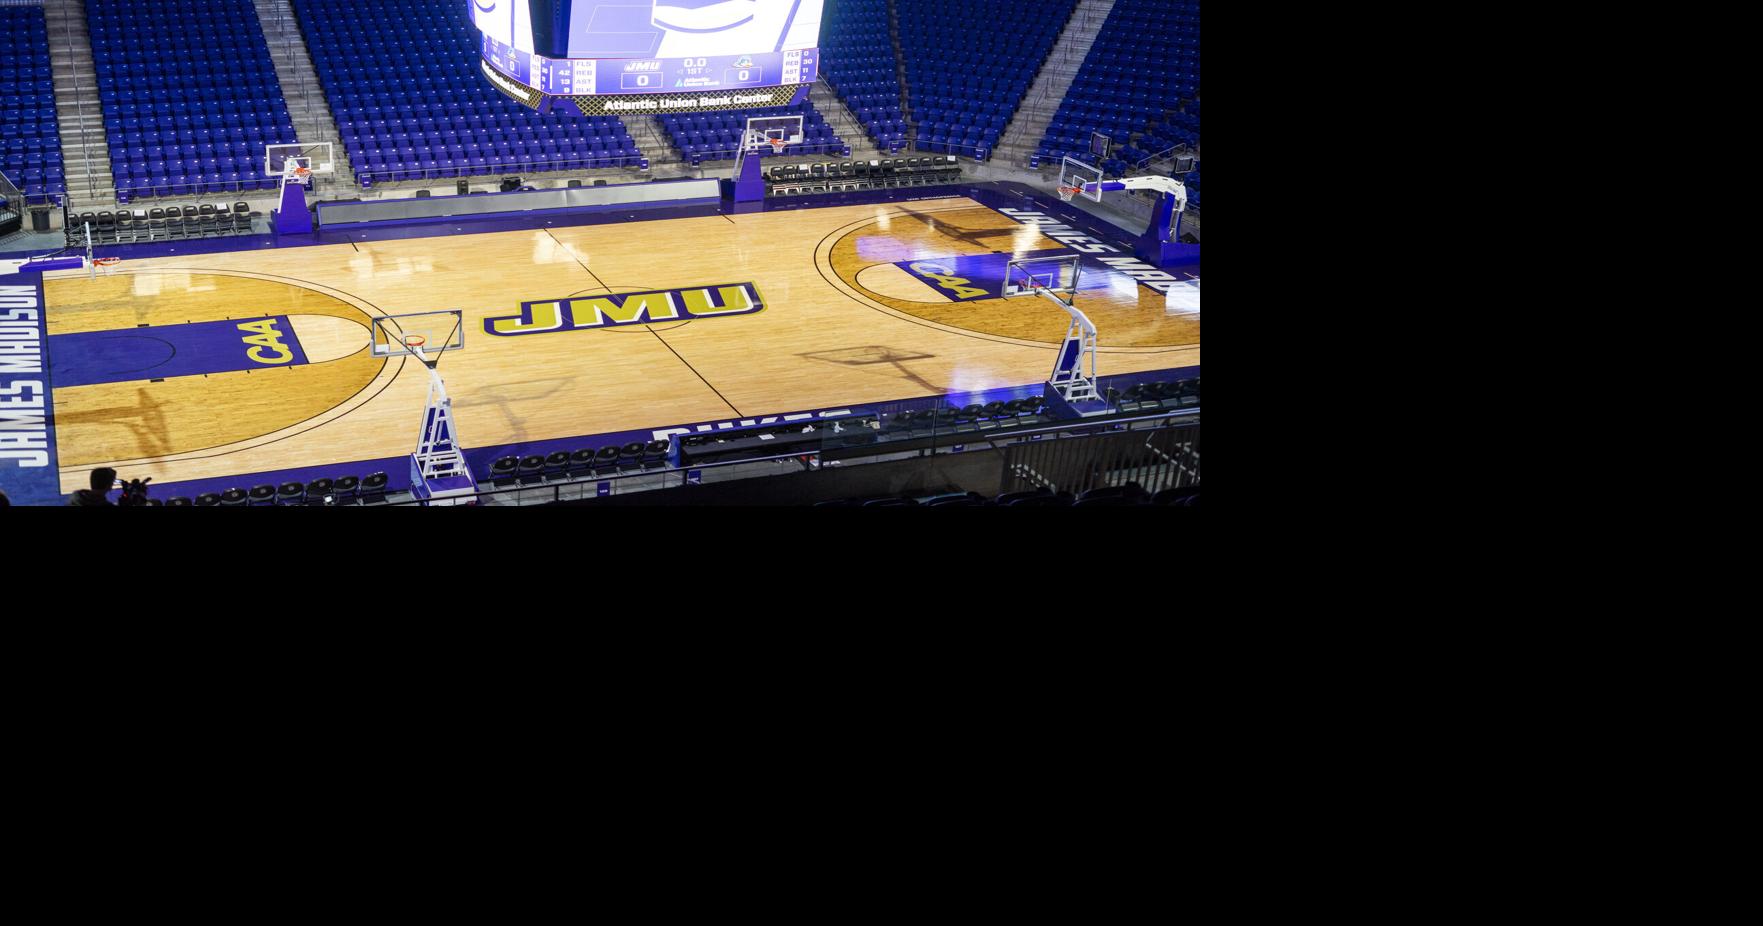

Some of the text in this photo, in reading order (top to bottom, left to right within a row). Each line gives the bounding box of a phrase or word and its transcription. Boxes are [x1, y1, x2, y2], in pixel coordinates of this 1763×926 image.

[624, 61, 660, 72] JMU
[683, 58, 707, 68] 0.0
[738, 70, 749, 81] 0
[637, 75, 649, 86] 0
[604, 93, 773, 110] Atlantic Union Bank Center
[998, 208, 1120, 252] JAMES
[910, 262, 990, 299] CAA
[484, 283, 764, 335] JMU
[237, 318, 293, 364] CAA
[0, 285, 49, 467] JAMES MADISON
